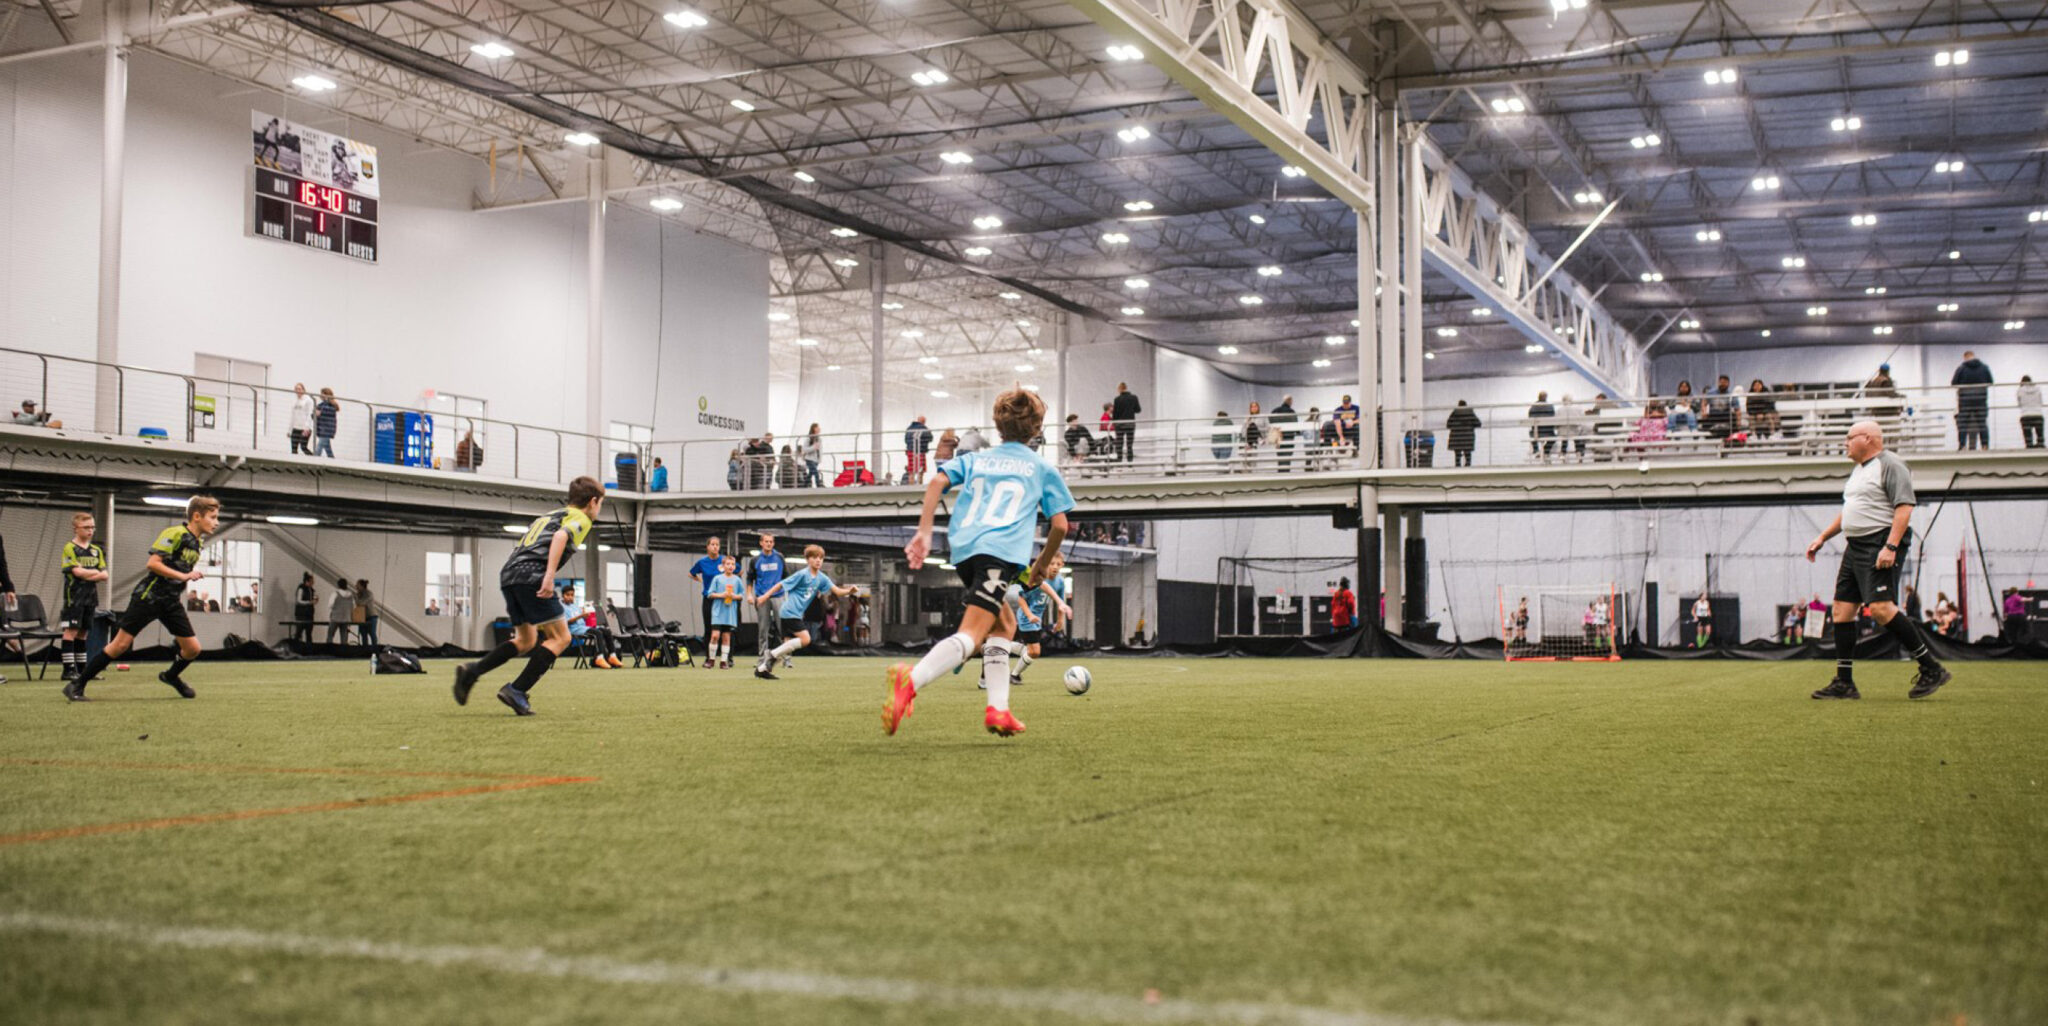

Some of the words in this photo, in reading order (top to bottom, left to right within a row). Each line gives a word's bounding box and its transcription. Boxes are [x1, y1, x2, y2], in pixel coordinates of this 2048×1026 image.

[274, 178, 289, 195] MIN
[301, 182, 342, 213] 16:40
[348, 198, 362, 214] SEC
[263, 221, 284, 239] HOME
[319, 212, 325, 232] 1
[305, 231, 331, 250] PERIOD
[348, 241, 374, 260] GUESTS
[698, 412, 745, 431] CONCESSION
[960, 477, 1026, 527] 10
